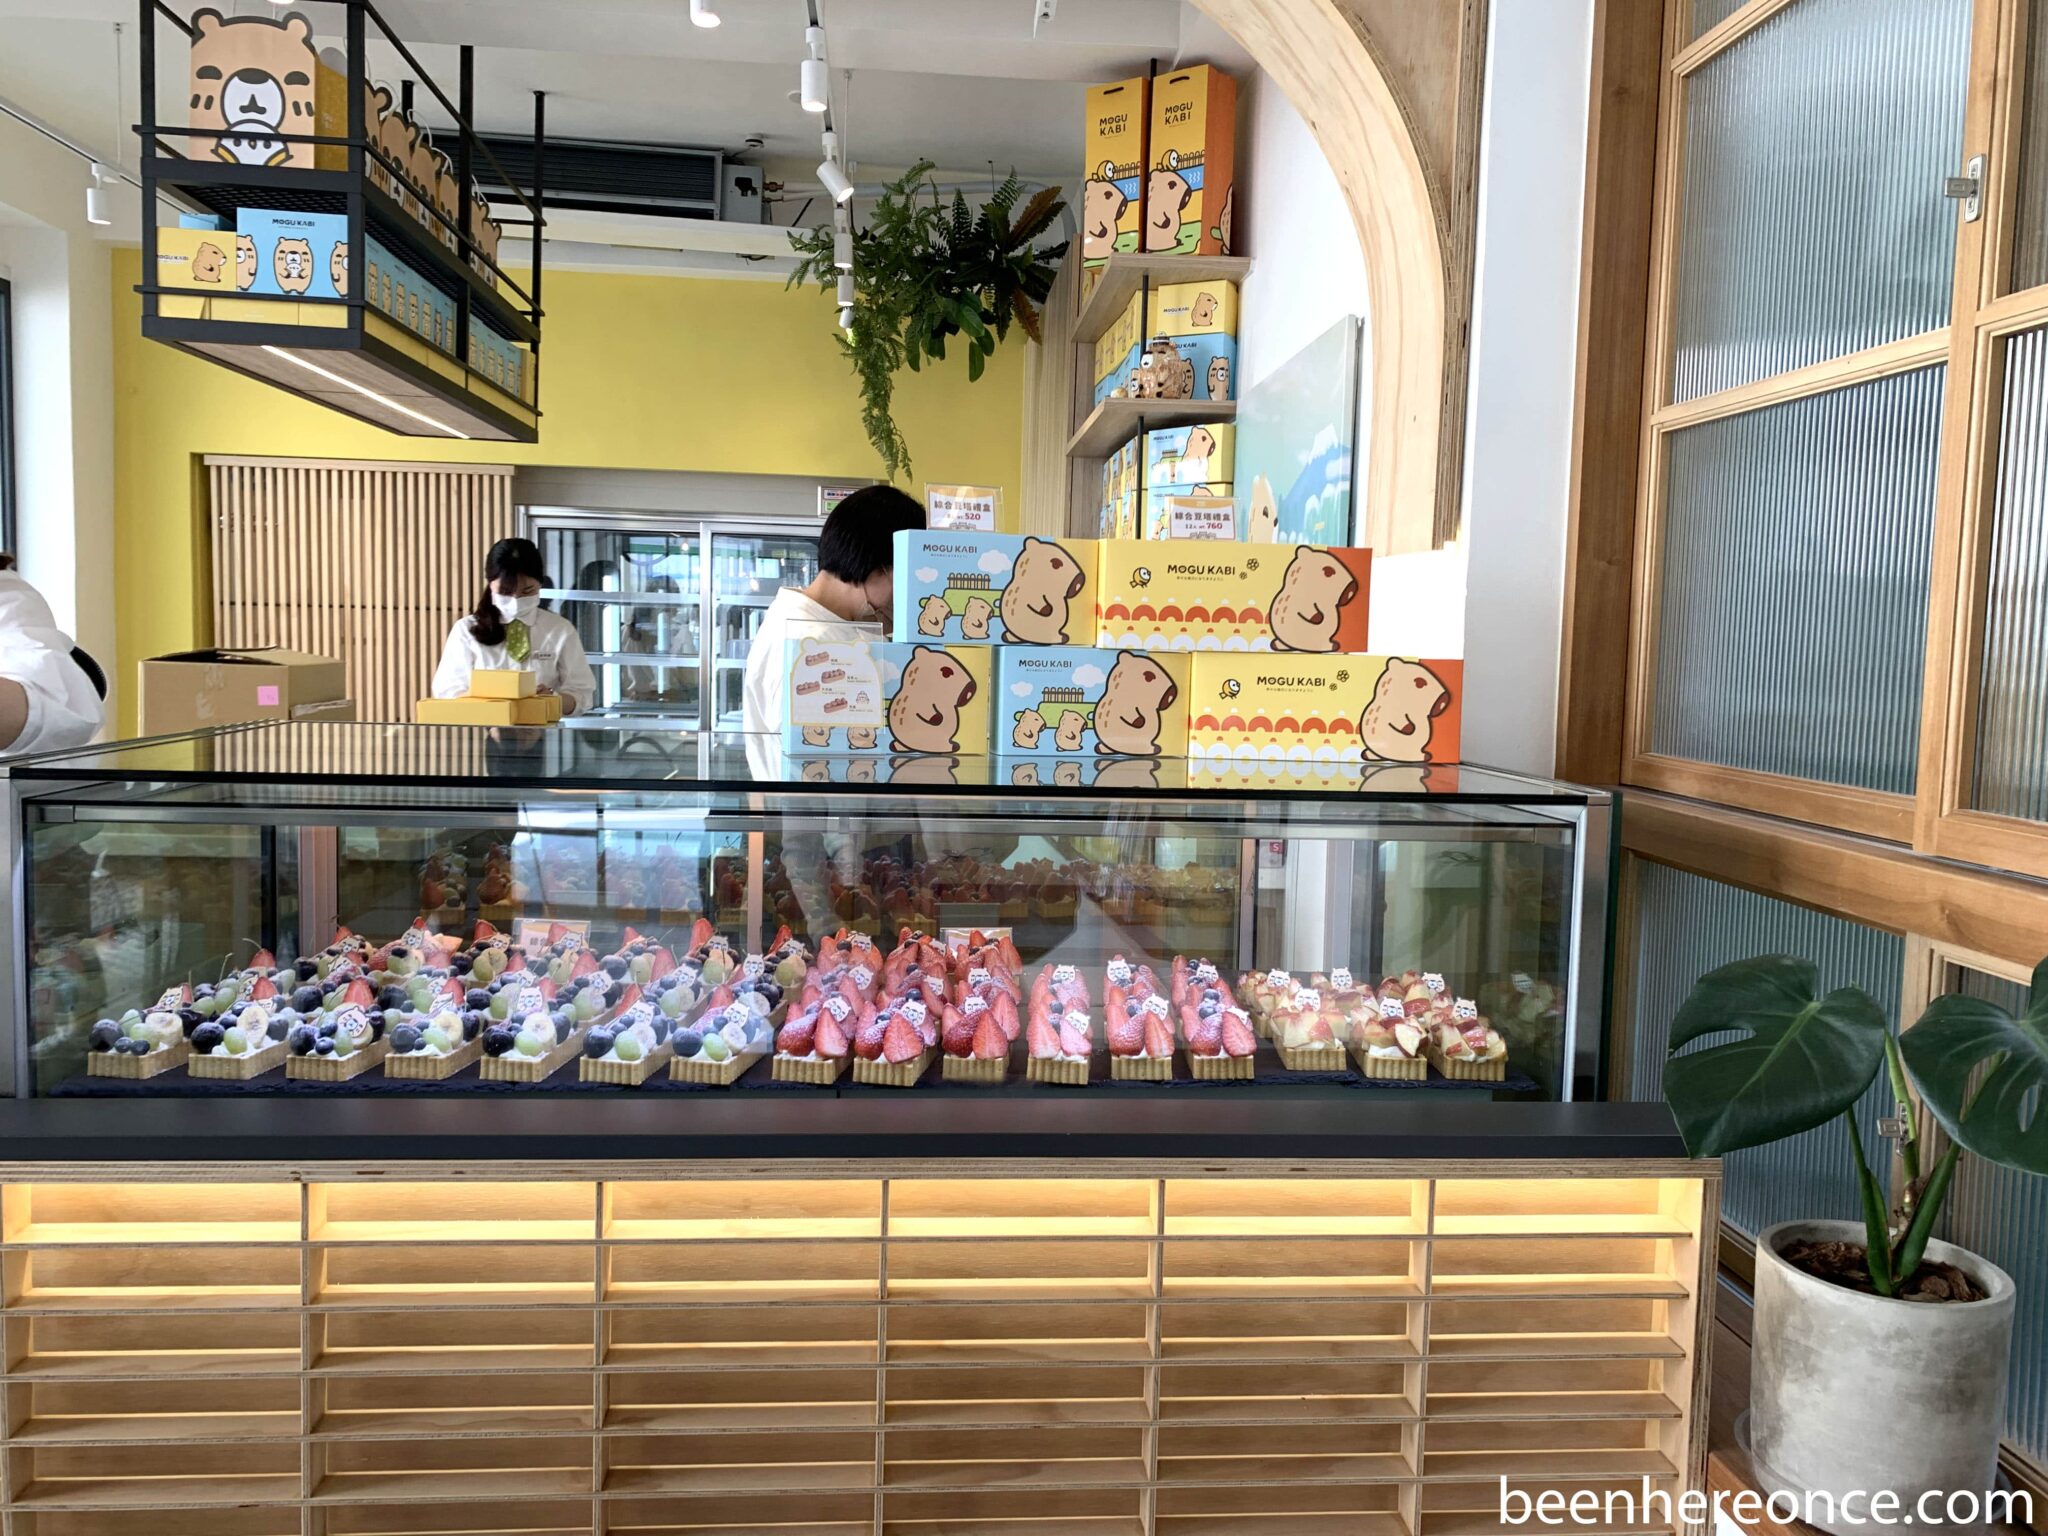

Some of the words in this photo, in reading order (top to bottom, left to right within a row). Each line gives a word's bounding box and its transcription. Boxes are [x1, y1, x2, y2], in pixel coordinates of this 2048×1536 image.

[1165, 102, 1193, 115] MOGU
[1099, 113, 1128, 127] MOGU
[1165, 112, 1191, 126] KABI
[1099, 124, 1127, 137] KABI
[272, 218, 296, 226] MOGU
[964, 512, 981, 521] 520
[1206, 522, 1223, 530] 760
[923, 543, 953, 553] MOGU
[955, 545, 978, 554] KABI
[1167, 564, 1205, 575] MOGU
[1207, 565, 1236, 576] KABI
[1018, 659, 1048, 669] MOGU
[1049, 660, 1073, 669] KABI
[1257, 676, 1295, 687] MOGU
[1297, 677, 1326, 687] KABI
